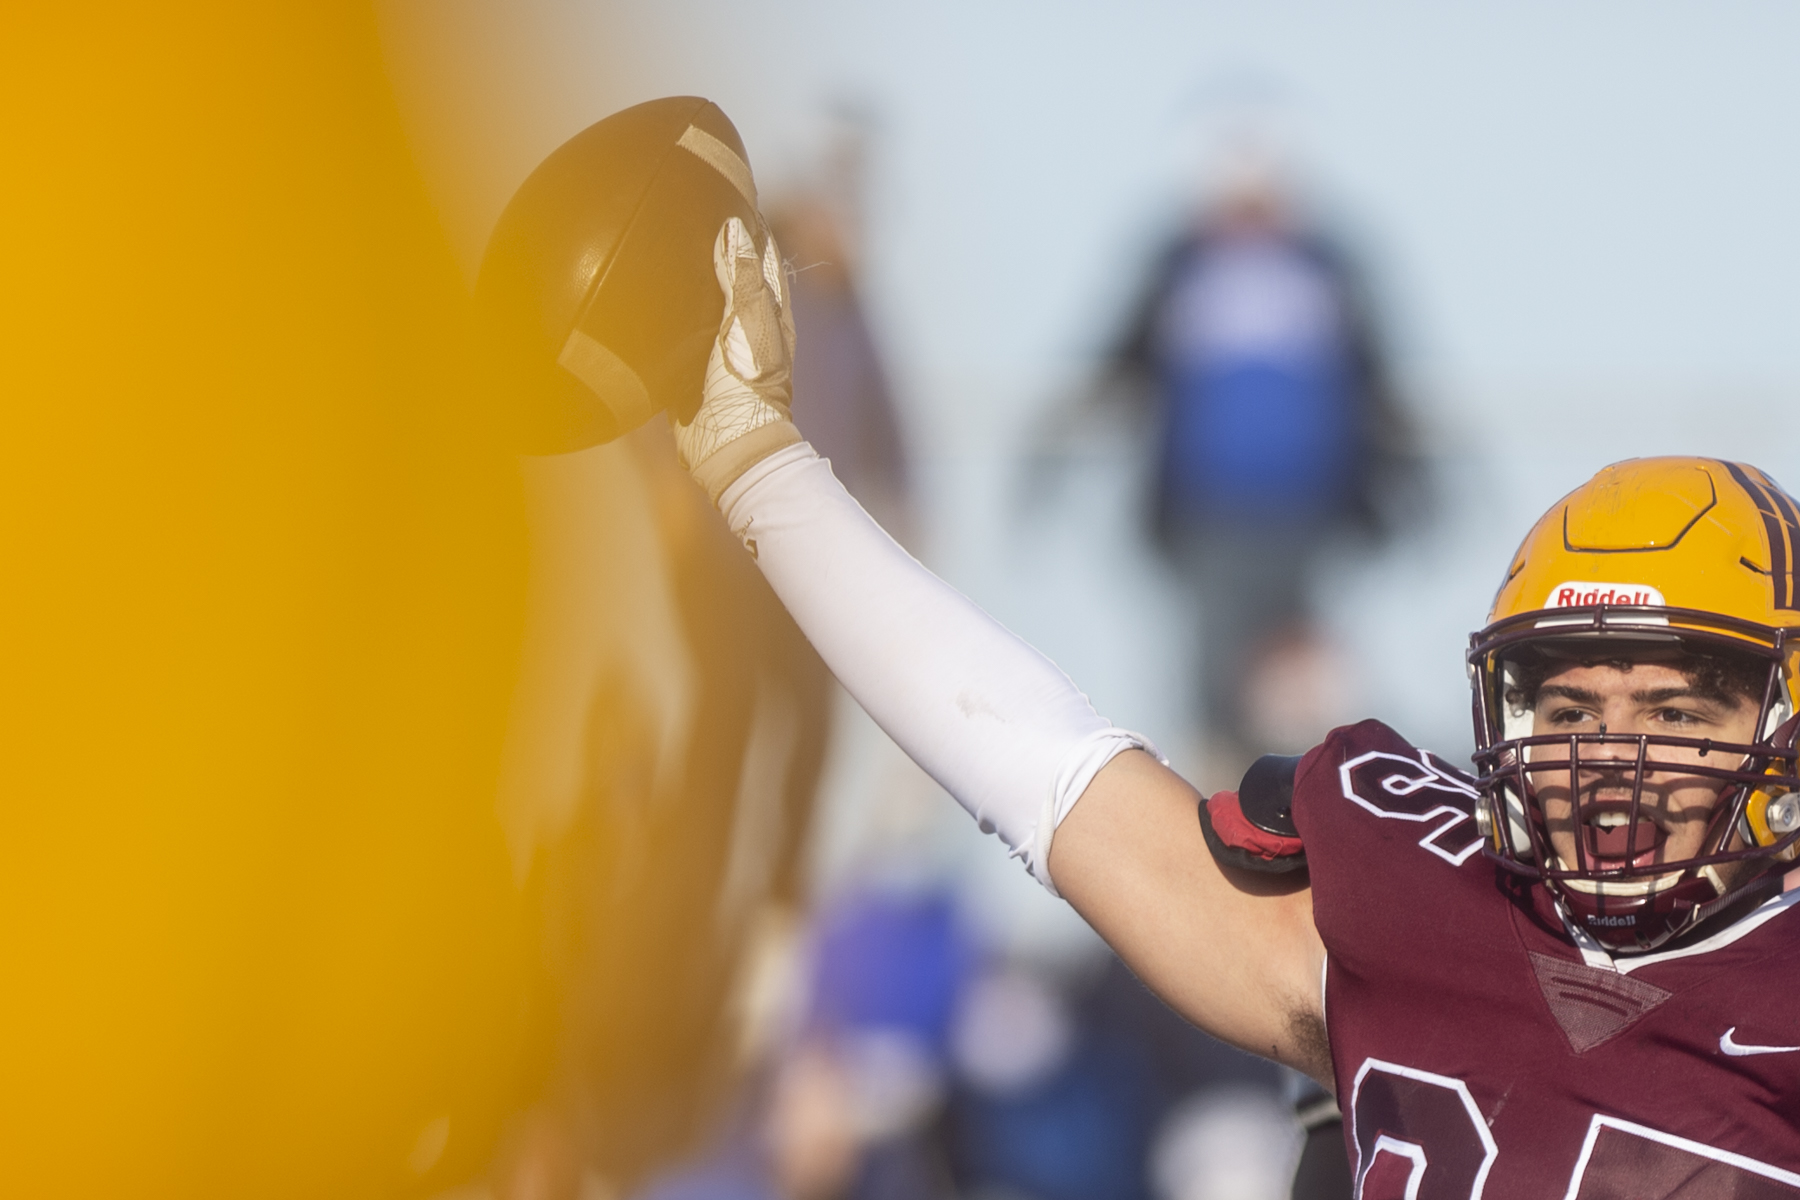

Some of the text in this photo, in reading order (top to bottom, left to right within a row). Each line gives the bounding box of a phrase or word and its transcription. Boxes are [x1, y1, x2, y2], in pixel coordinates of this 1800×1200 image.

[1557, 588, 1650, 607] Riddell
[1338, 748, 1485, 867] 5
[1587, 914, 1636, 927] Riddell
